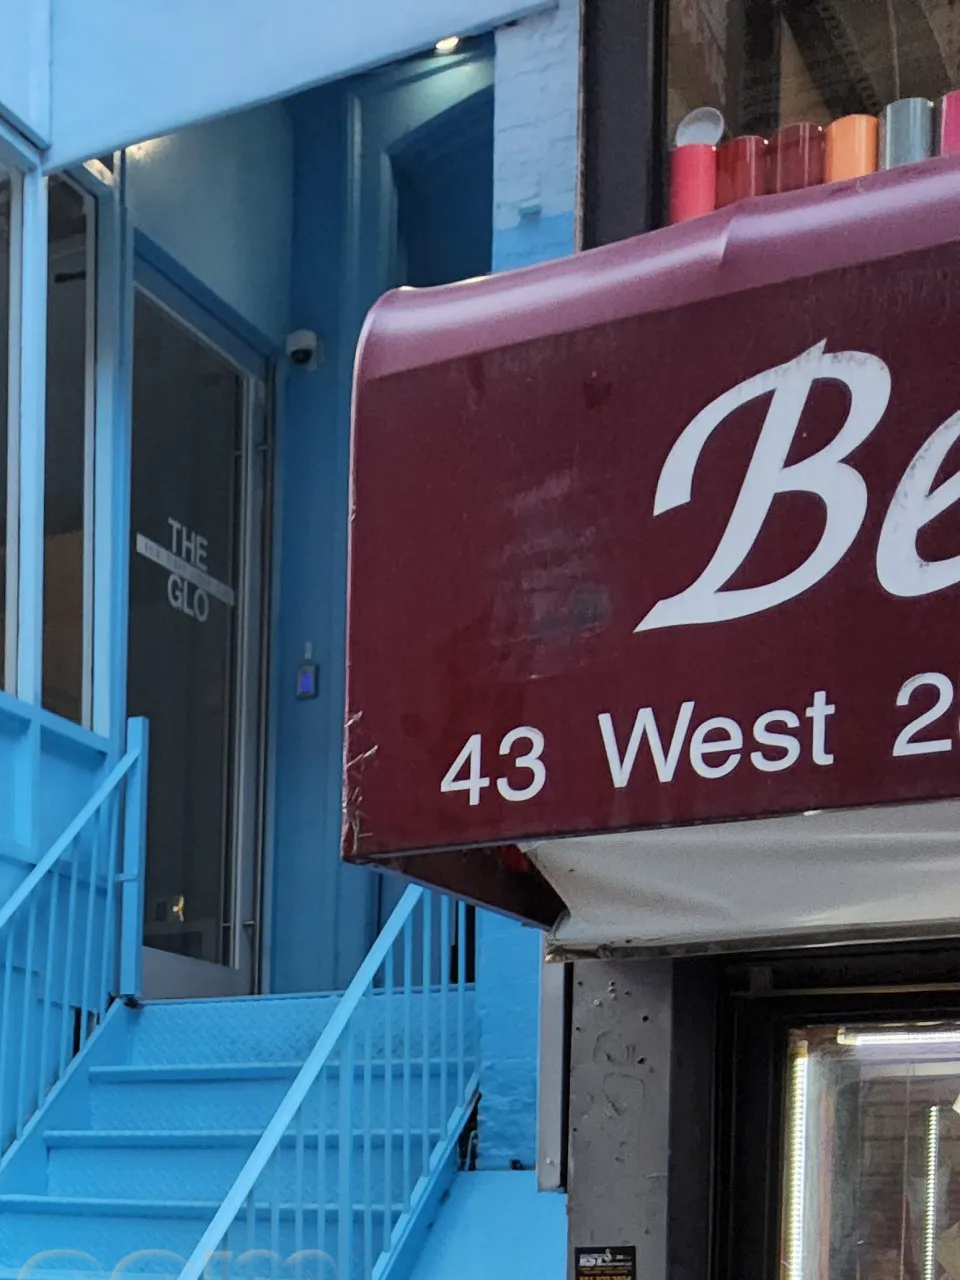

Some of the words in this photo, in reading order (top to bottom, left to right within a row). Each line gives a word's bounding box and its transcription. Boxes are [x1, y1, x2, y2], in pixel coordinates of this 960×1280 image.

[167, 517, 209, 572] THE
[167, 573, 210, 623] GLO
[440, 726, 547, 806] 43
[598, 690, 837, 789] West
